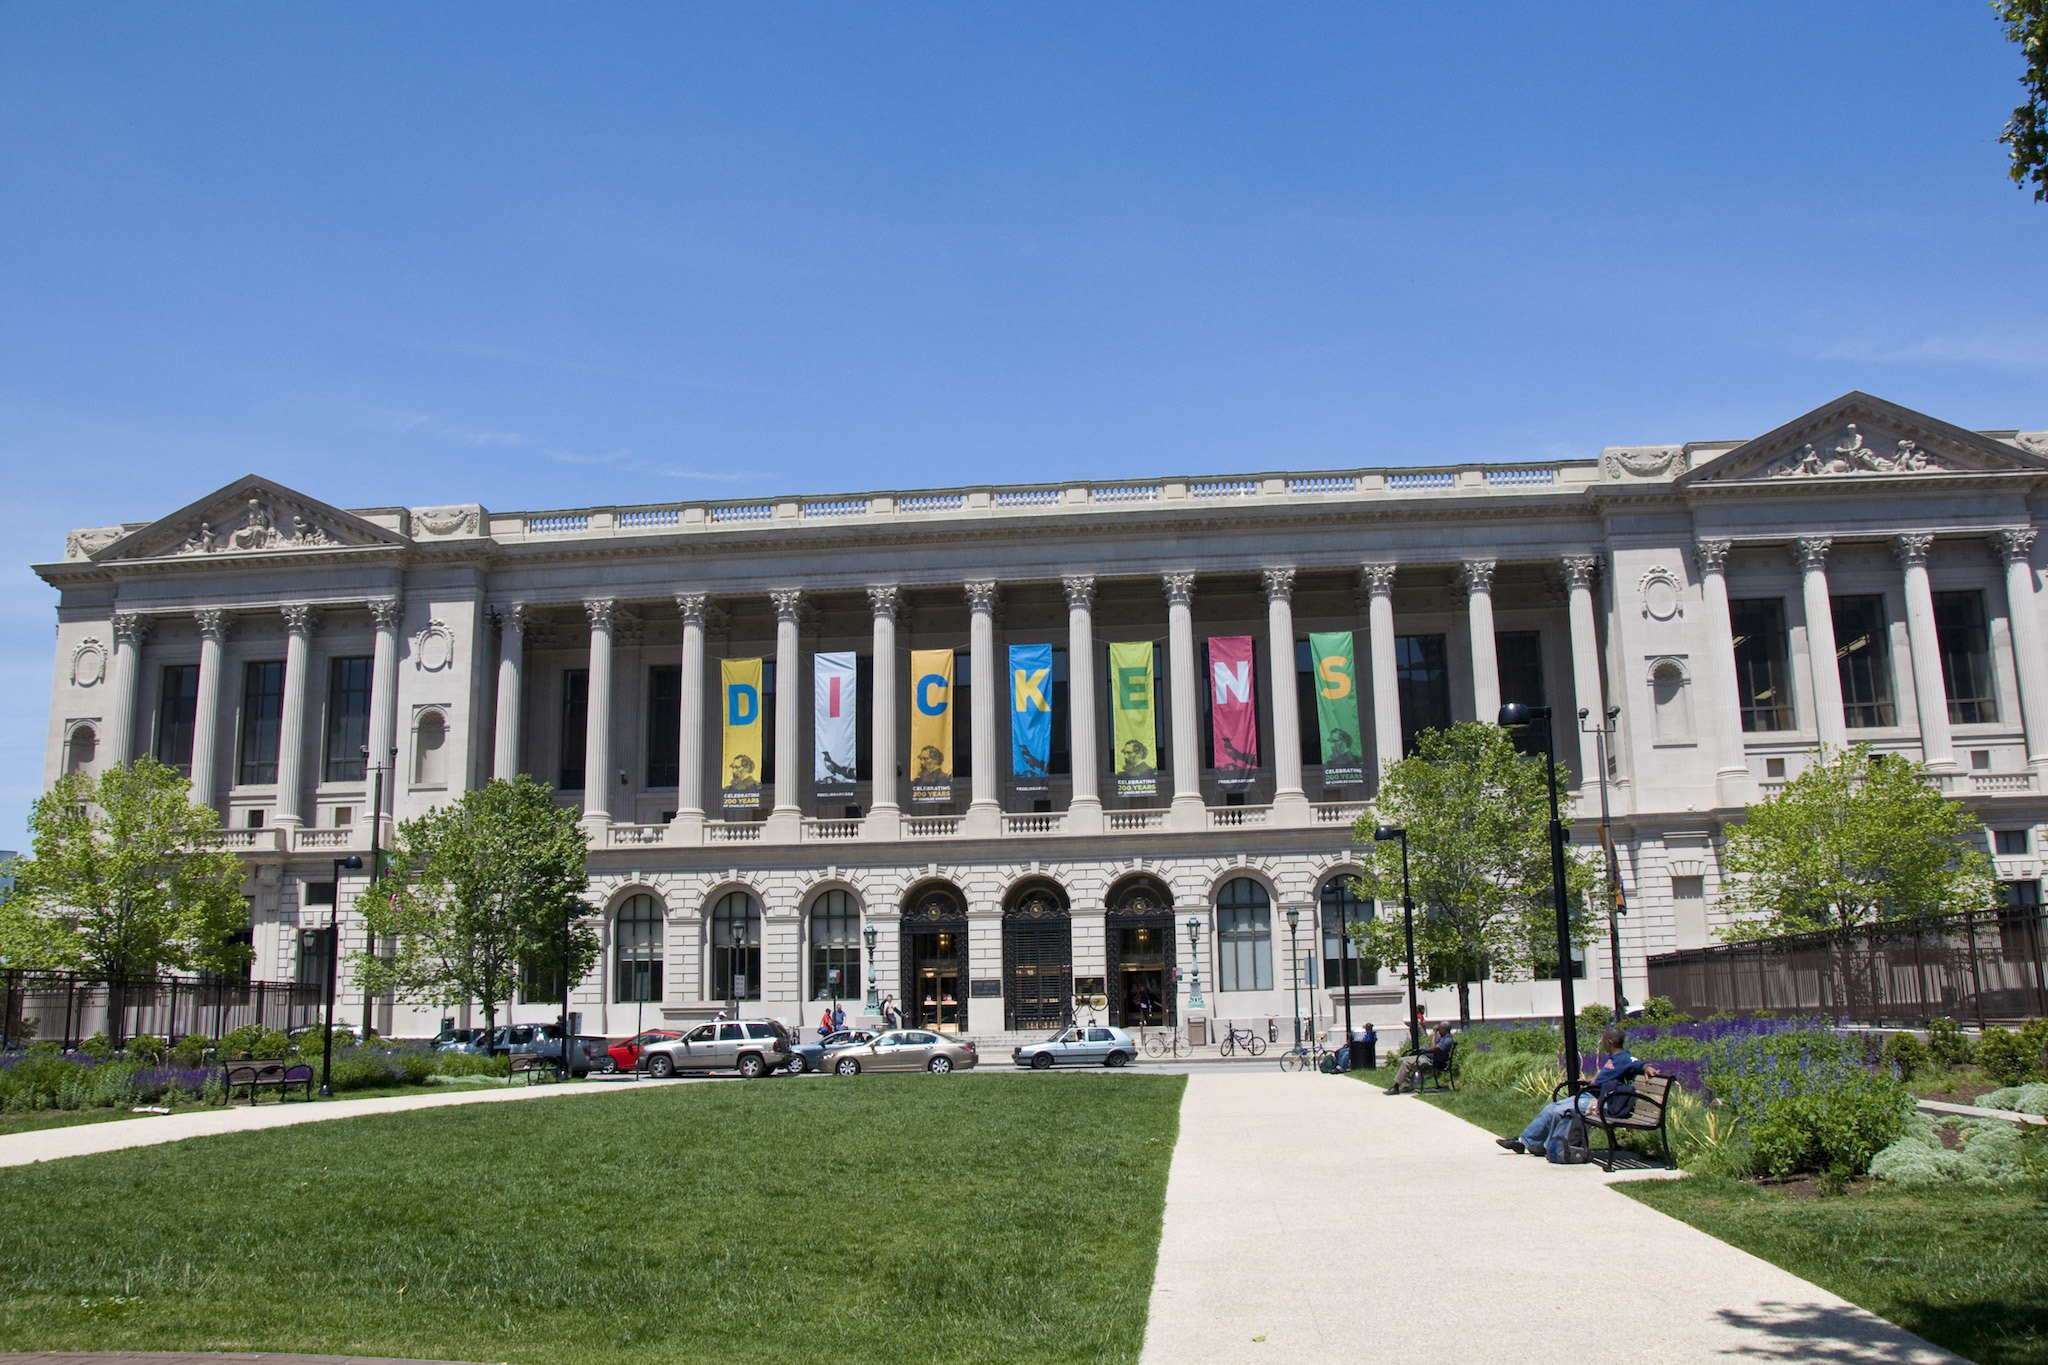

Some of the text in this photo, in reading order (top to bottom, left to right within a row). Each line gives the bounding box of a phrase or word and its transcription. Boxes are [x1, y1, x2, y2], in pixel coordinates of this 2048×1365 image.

[830, 677, 840, 718] I
[917, 674, 948, 716] C
[1015, 669, 1051, 712] K
[1119, 667, 1149, 710] E
[1214, 661, 1250, 704] N
[1319, 656, 1352, 699] S
[728, 684, 758, 726] D
